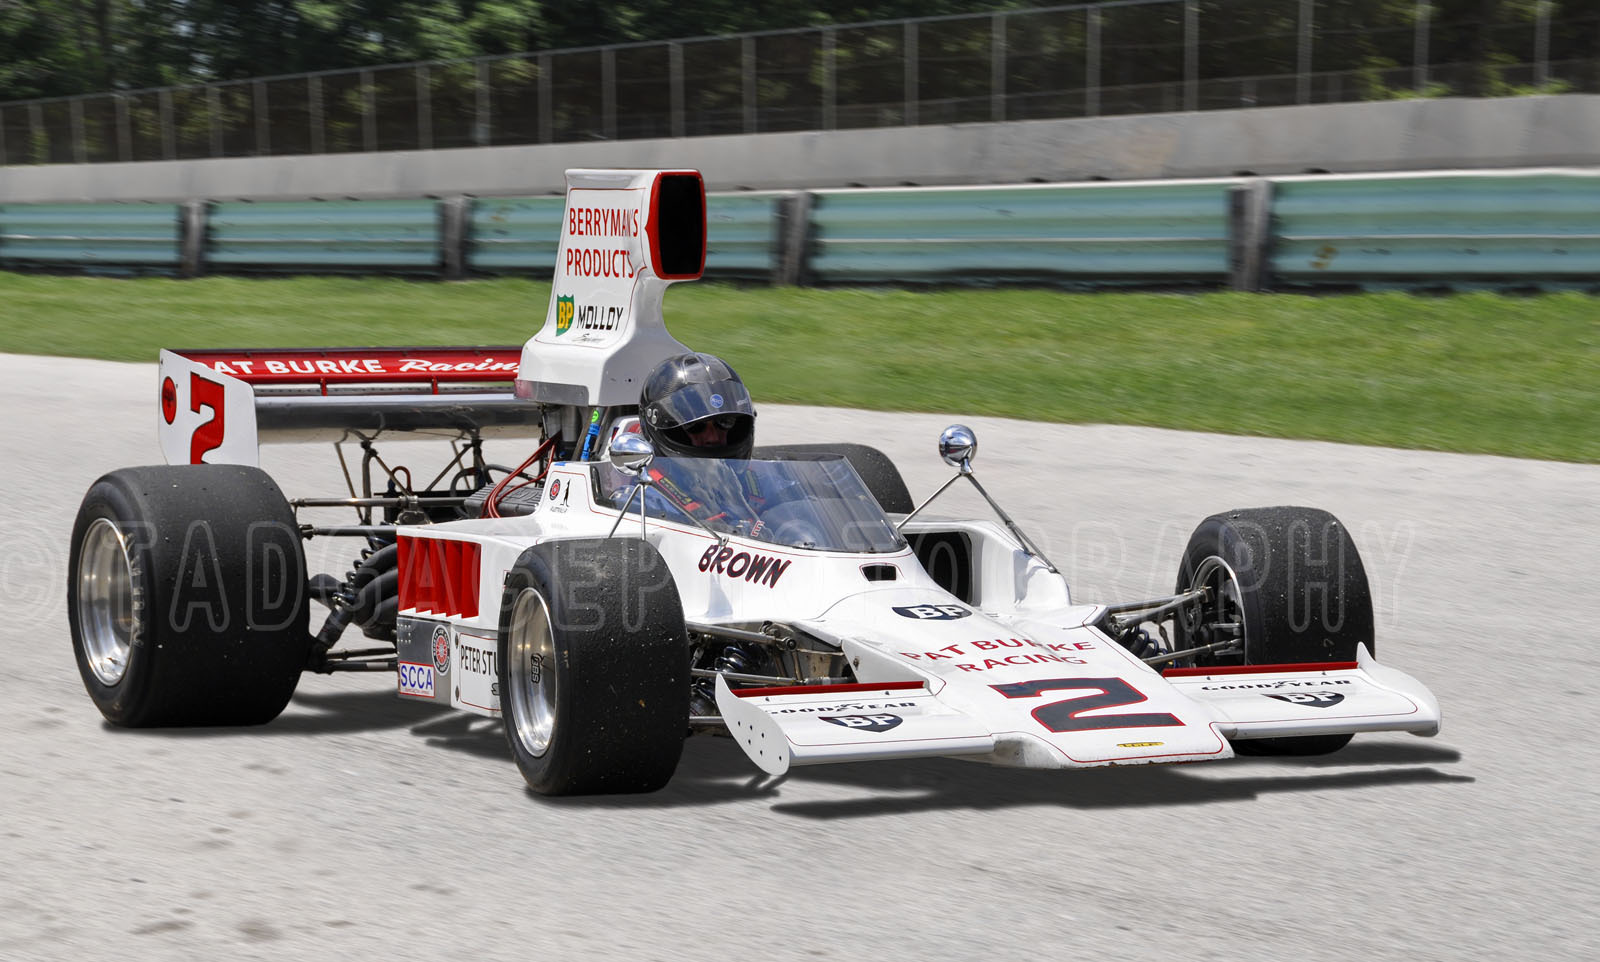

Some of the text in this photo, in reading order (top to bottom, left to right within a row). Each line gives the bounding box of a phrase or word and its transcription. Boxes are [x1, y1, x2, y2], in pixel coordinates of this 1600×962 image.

[569, 207, 639, 237] BERRYMAN'S
[566, 248, 634, 278] PRODUCTS
[557, 301, 574, 329] BP
[577, 305, 624, 331] MOLLOY
[198, 357, 520, 375] AT BURKE Racin
[698, 544, 792, 589] BROWN
[906, 604, 967, 620] BP
[460, 644, 481, 674] PETER
[899, 644, 966, 661] PAT
[954, 653, 1089, 673] RACING
[400, 664, 433, 690] SCCA
[1201, 679, 1352, 691] GOODYEAR
[987, 676, 1187, 733] 2
[1280, 691, 1335, 703] BP
[833, 713, 896, 728] BP
